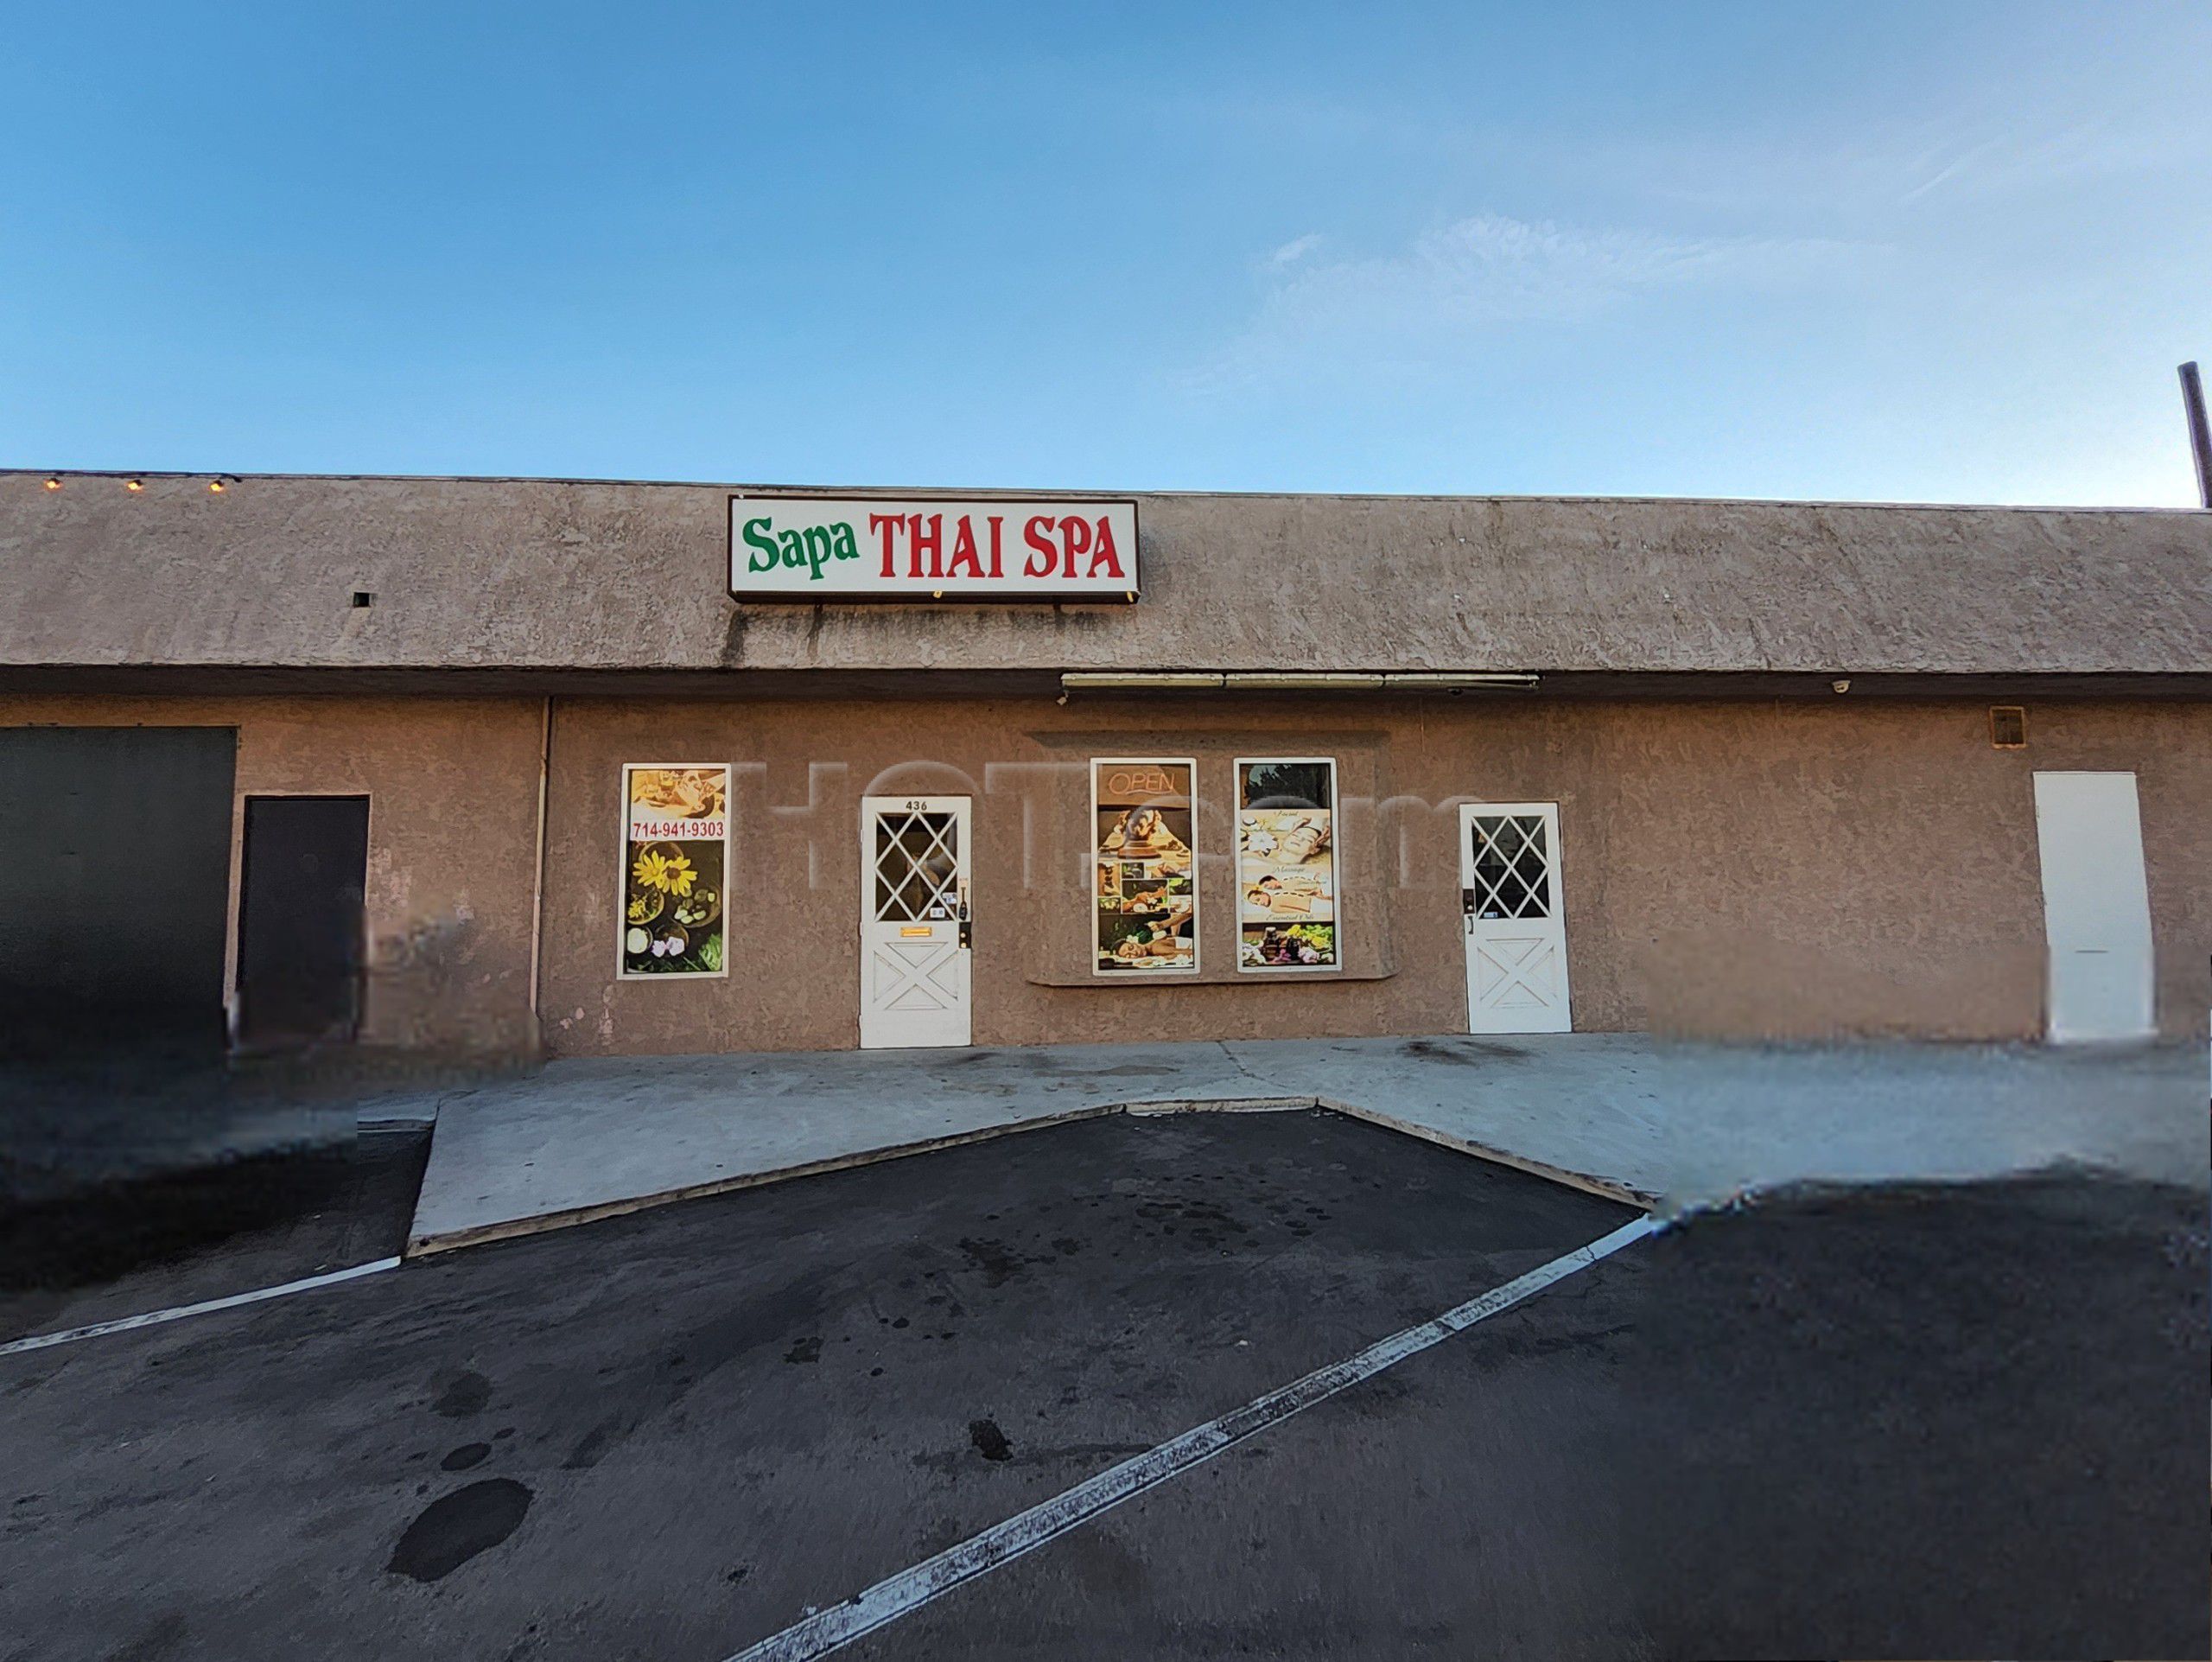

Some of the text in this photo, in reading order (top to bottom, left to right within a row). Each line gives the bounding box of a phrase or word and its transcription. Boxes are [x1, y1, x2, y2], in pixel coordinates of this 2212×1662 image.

[742, 513, 1126, 580] Sapa THAI SPA
[1109, 773, 1175, 794] OPEN
[906, 800, 927, 811] 436
[633, 821, 724, 837] 714-941-9303
